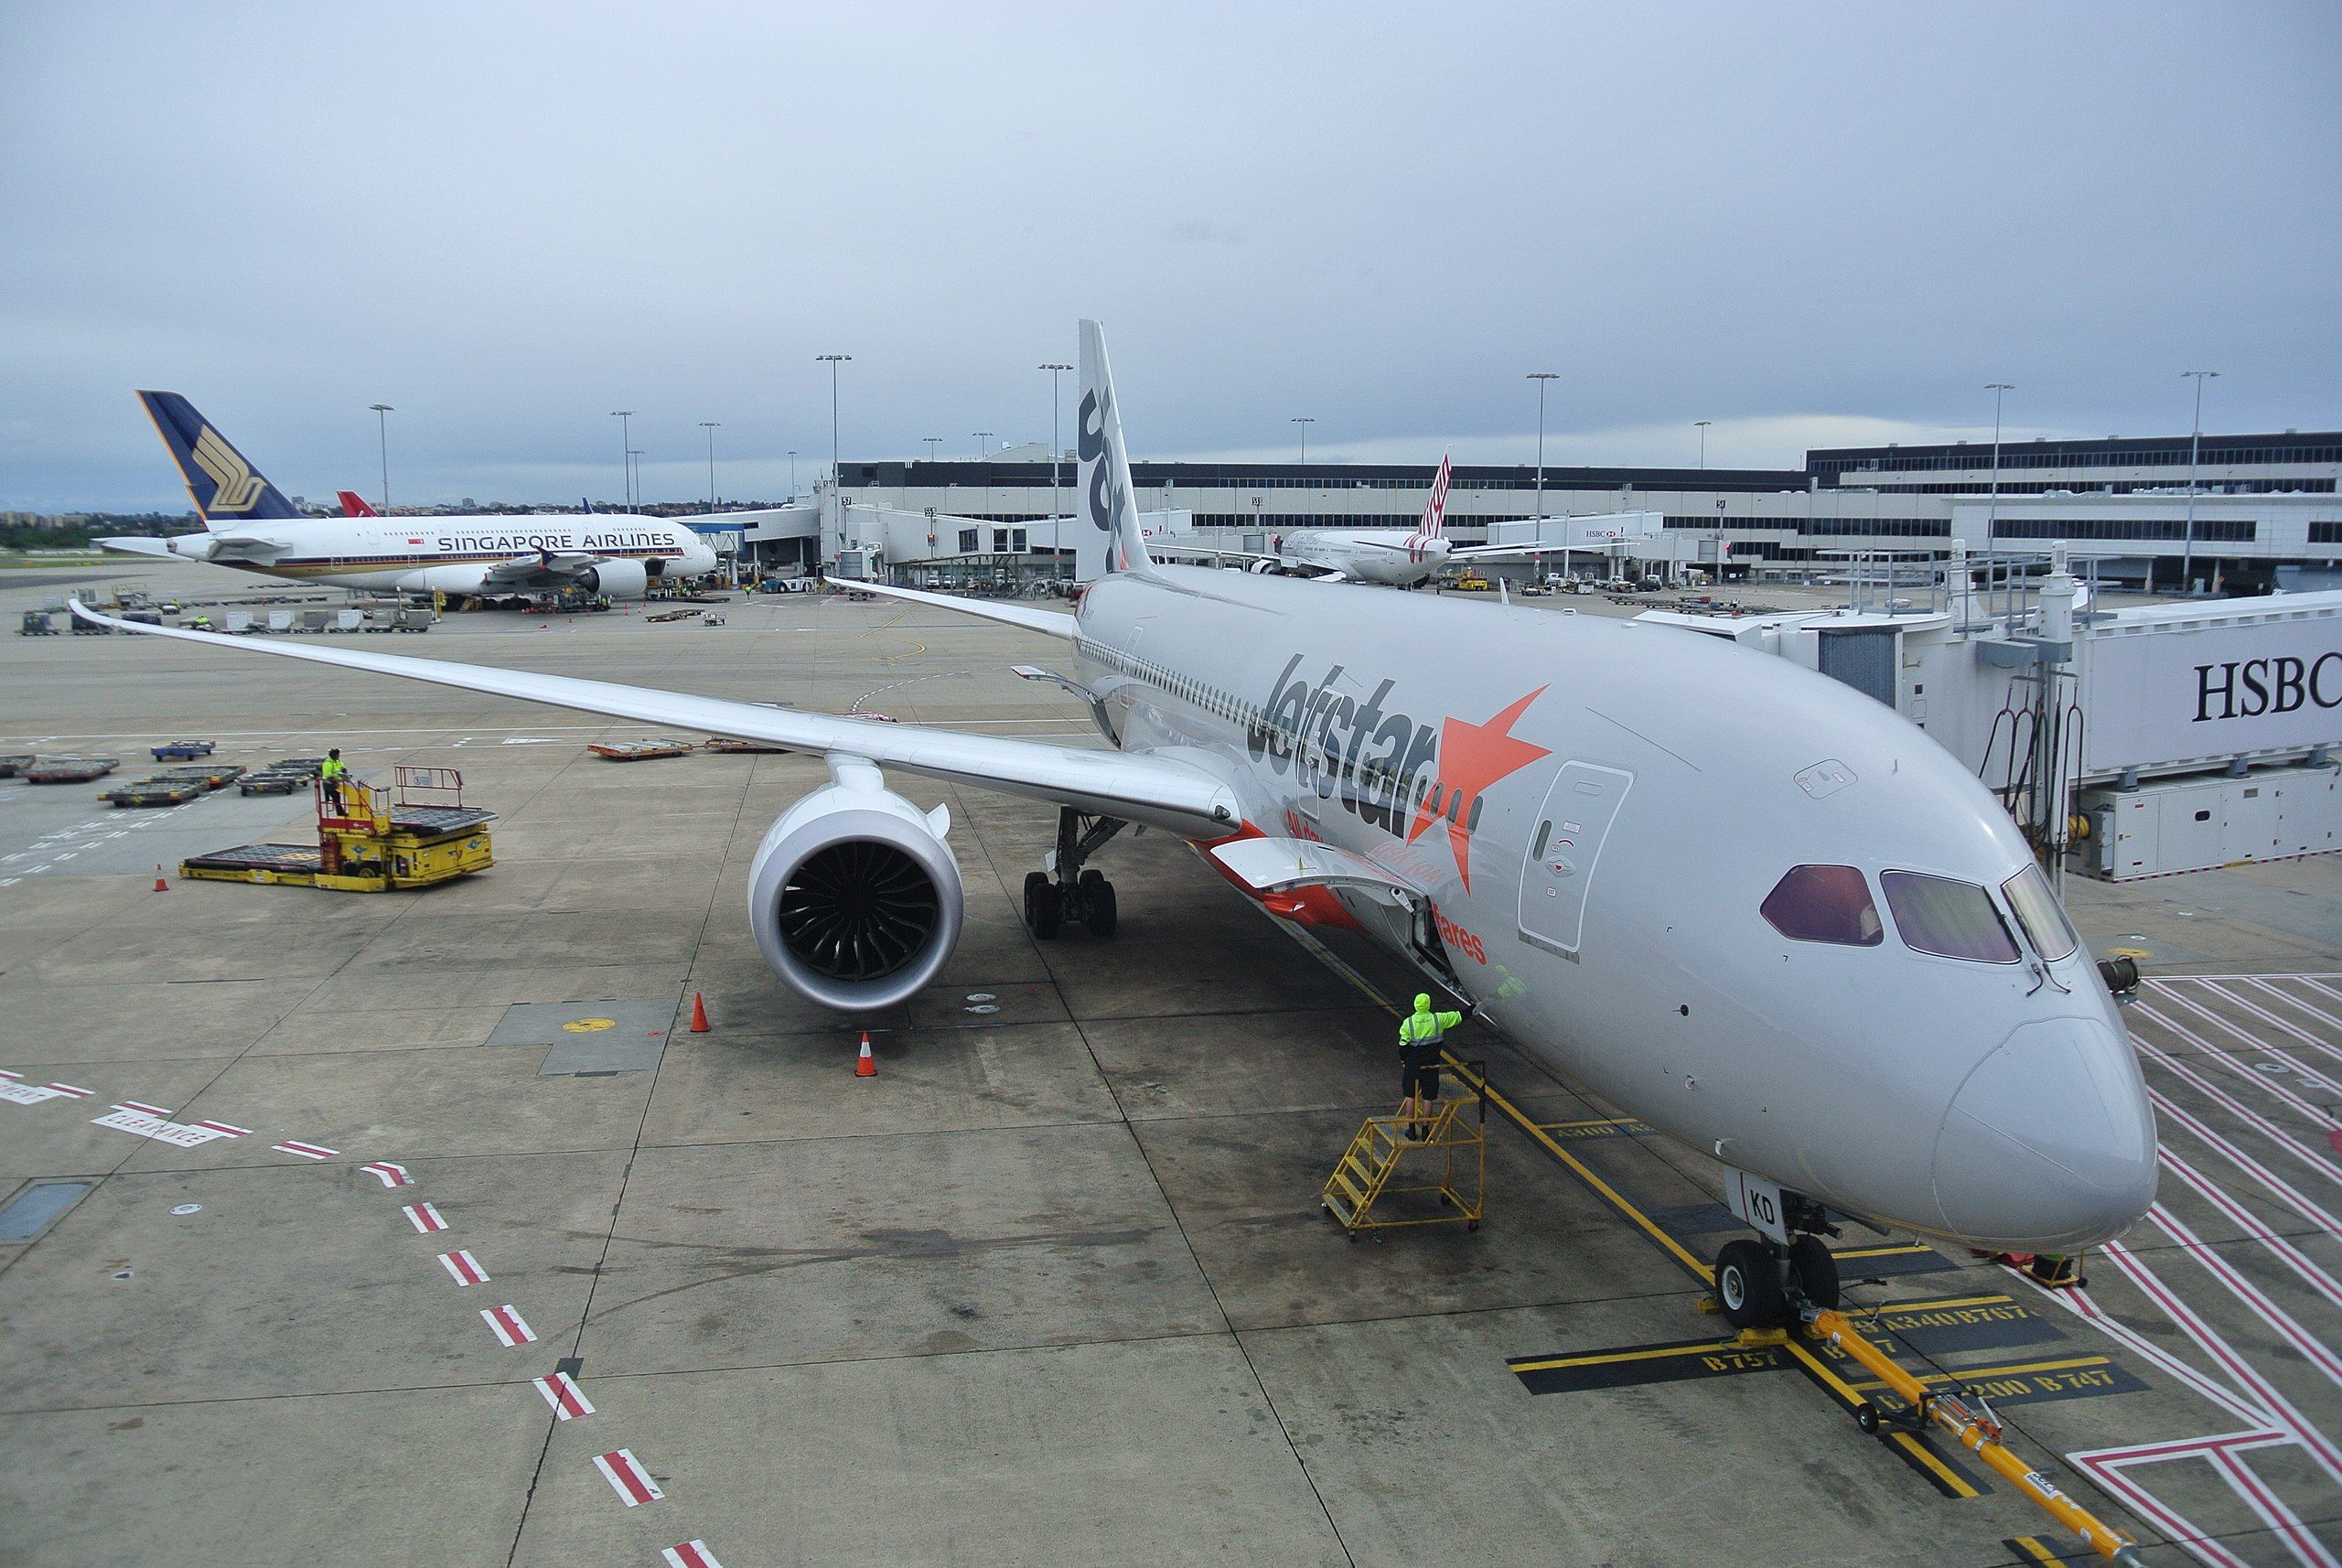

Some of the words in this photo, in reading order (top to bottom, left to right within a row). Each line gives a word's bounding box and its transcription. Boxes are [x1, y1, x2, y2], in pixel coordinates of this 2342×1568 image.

[438, 534, 573, 551] SINGAPORE
[582, 533, 675, 547] AIRLINES
[2192, 651, 2342, 723] HSBC
[108, 1114, 207, 1143] CLEARANCE
[1750, 1189, 1776, 1226] KD
[1884, 1313, 1960, 1332] A340
[1956, 1305, 2028, 1325] B767
